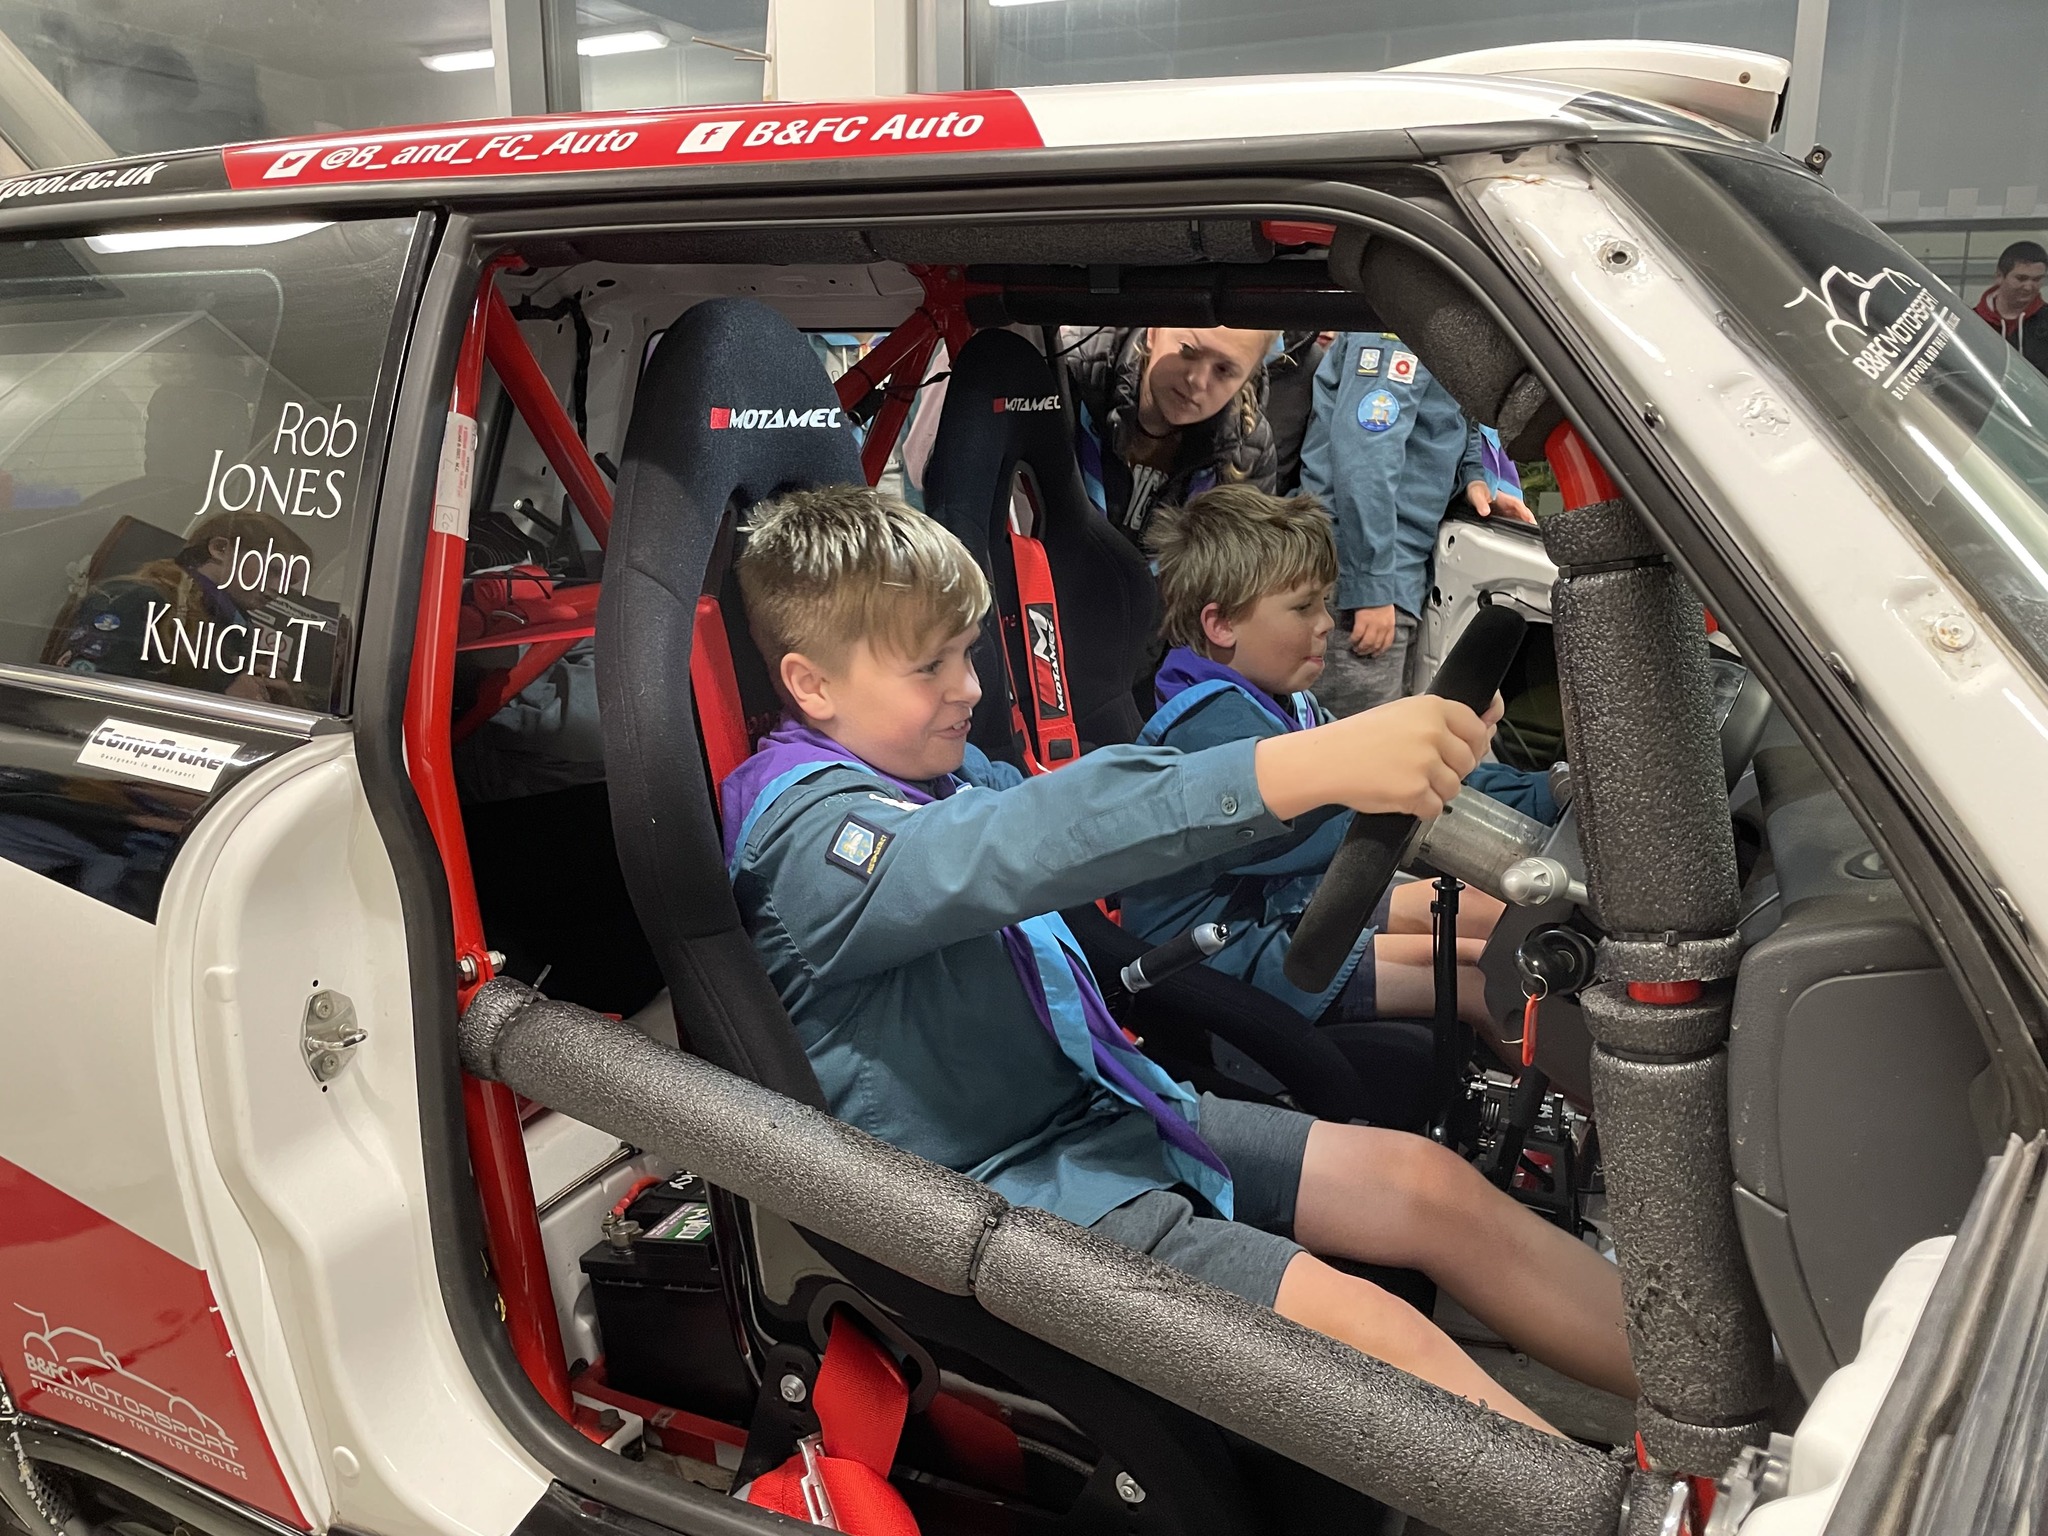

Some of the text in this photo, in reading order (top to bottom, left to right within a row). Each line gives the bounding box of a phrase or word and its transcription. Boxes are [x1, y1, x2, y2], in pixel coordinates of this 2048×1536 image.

[320, 129, 639, 170] @B_and_FC_Auto
[743, 114, 985, 147] B&FC Auto
[1891, 357, 1932, 400] BLACKPOOL
[729, 406, 841, 429] MOTAMEC
[1005, 395, 1061, 412] MOTAMEC
[274, 402, 357, 458] Rob
[195, 449, 345, 518] JONES
[217, 536, 311, 596] John
[140, 601, 326, 682] KNIGHT
[100, 753, 137, 766] Designers
[152, 764, 196, 779] Motorsport
[31, 1379, 248, 1480] BLACKPOOL AND THE FYLDE COLLEGE
